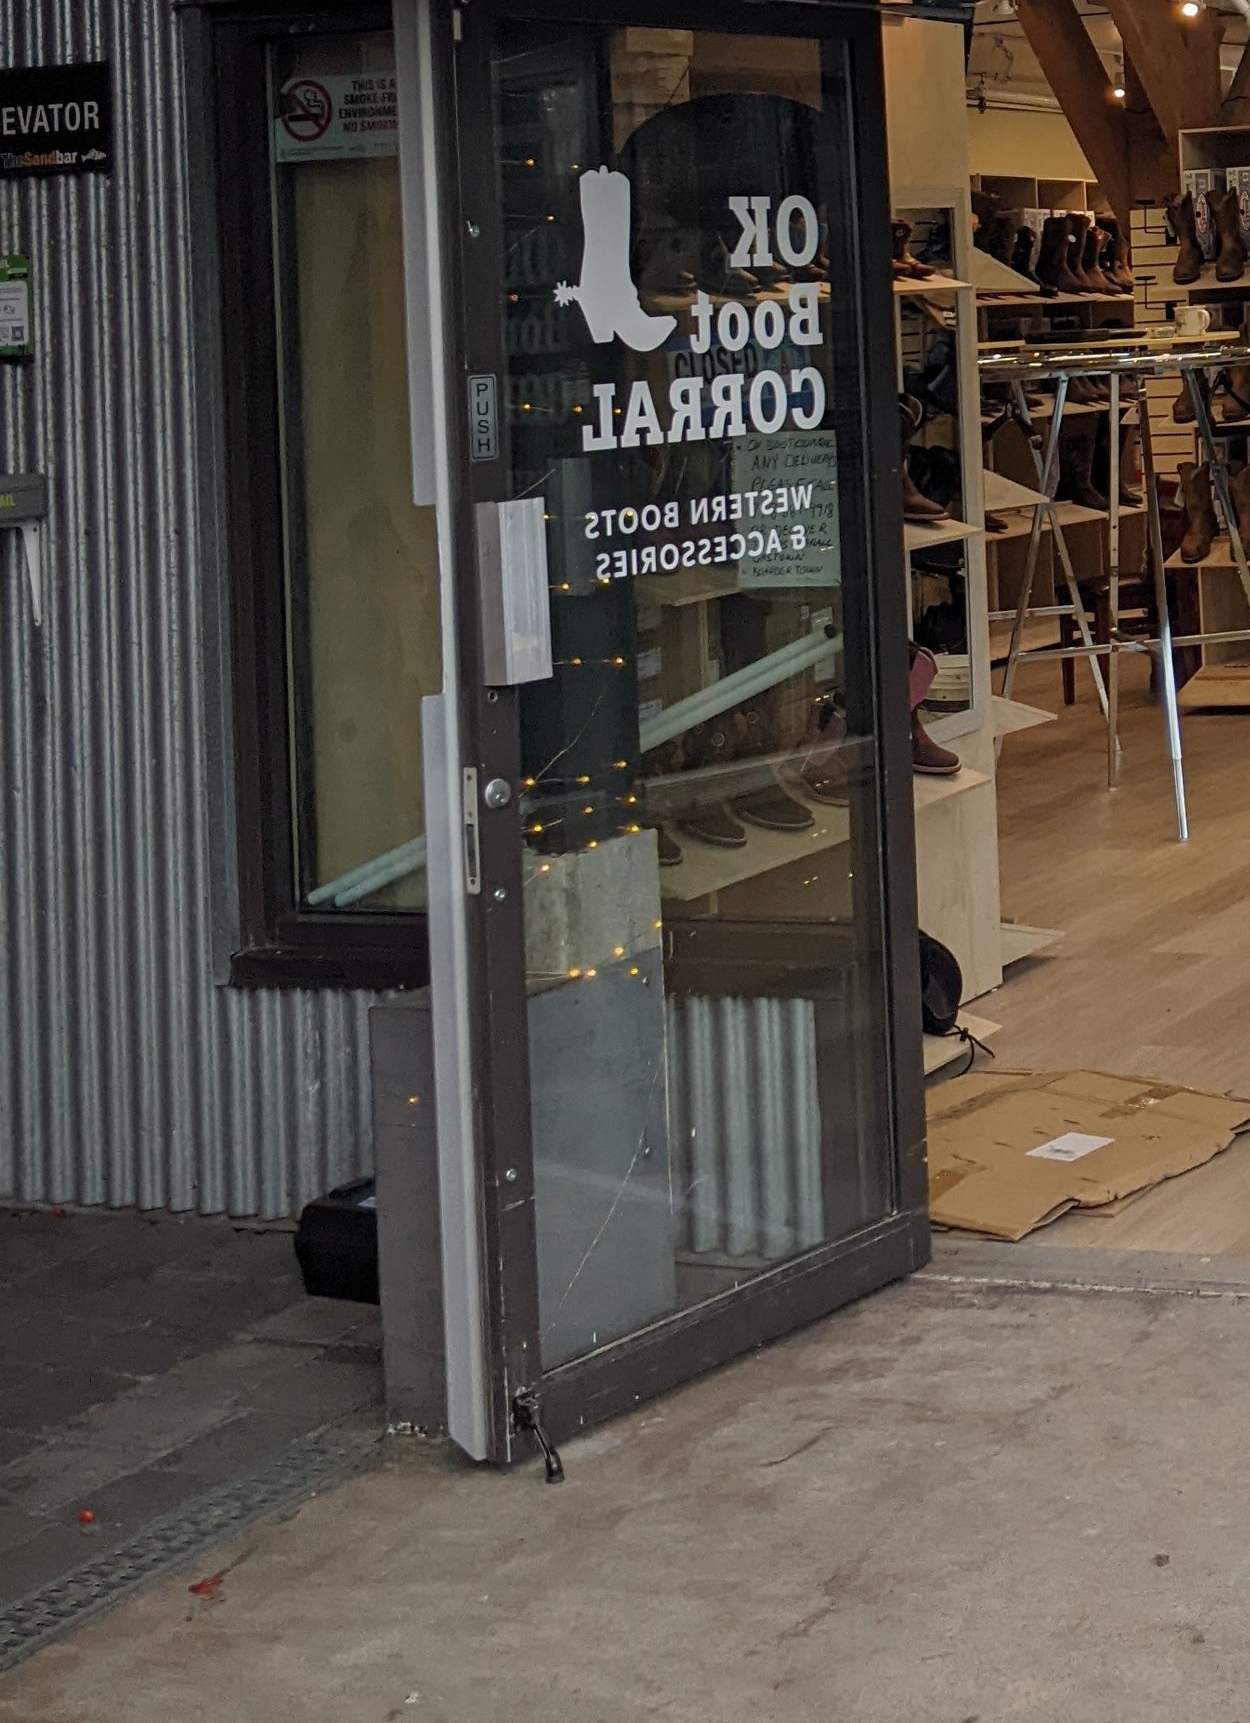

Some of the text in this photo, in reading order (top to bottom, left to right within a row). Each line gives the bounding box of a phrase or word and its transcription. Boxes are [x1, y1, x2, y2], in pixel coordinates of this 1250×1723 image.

[351, 79, 374, 91] THIS
[377, 79, 387, 90] IS
[476, 382, 490, 453] PUSH
